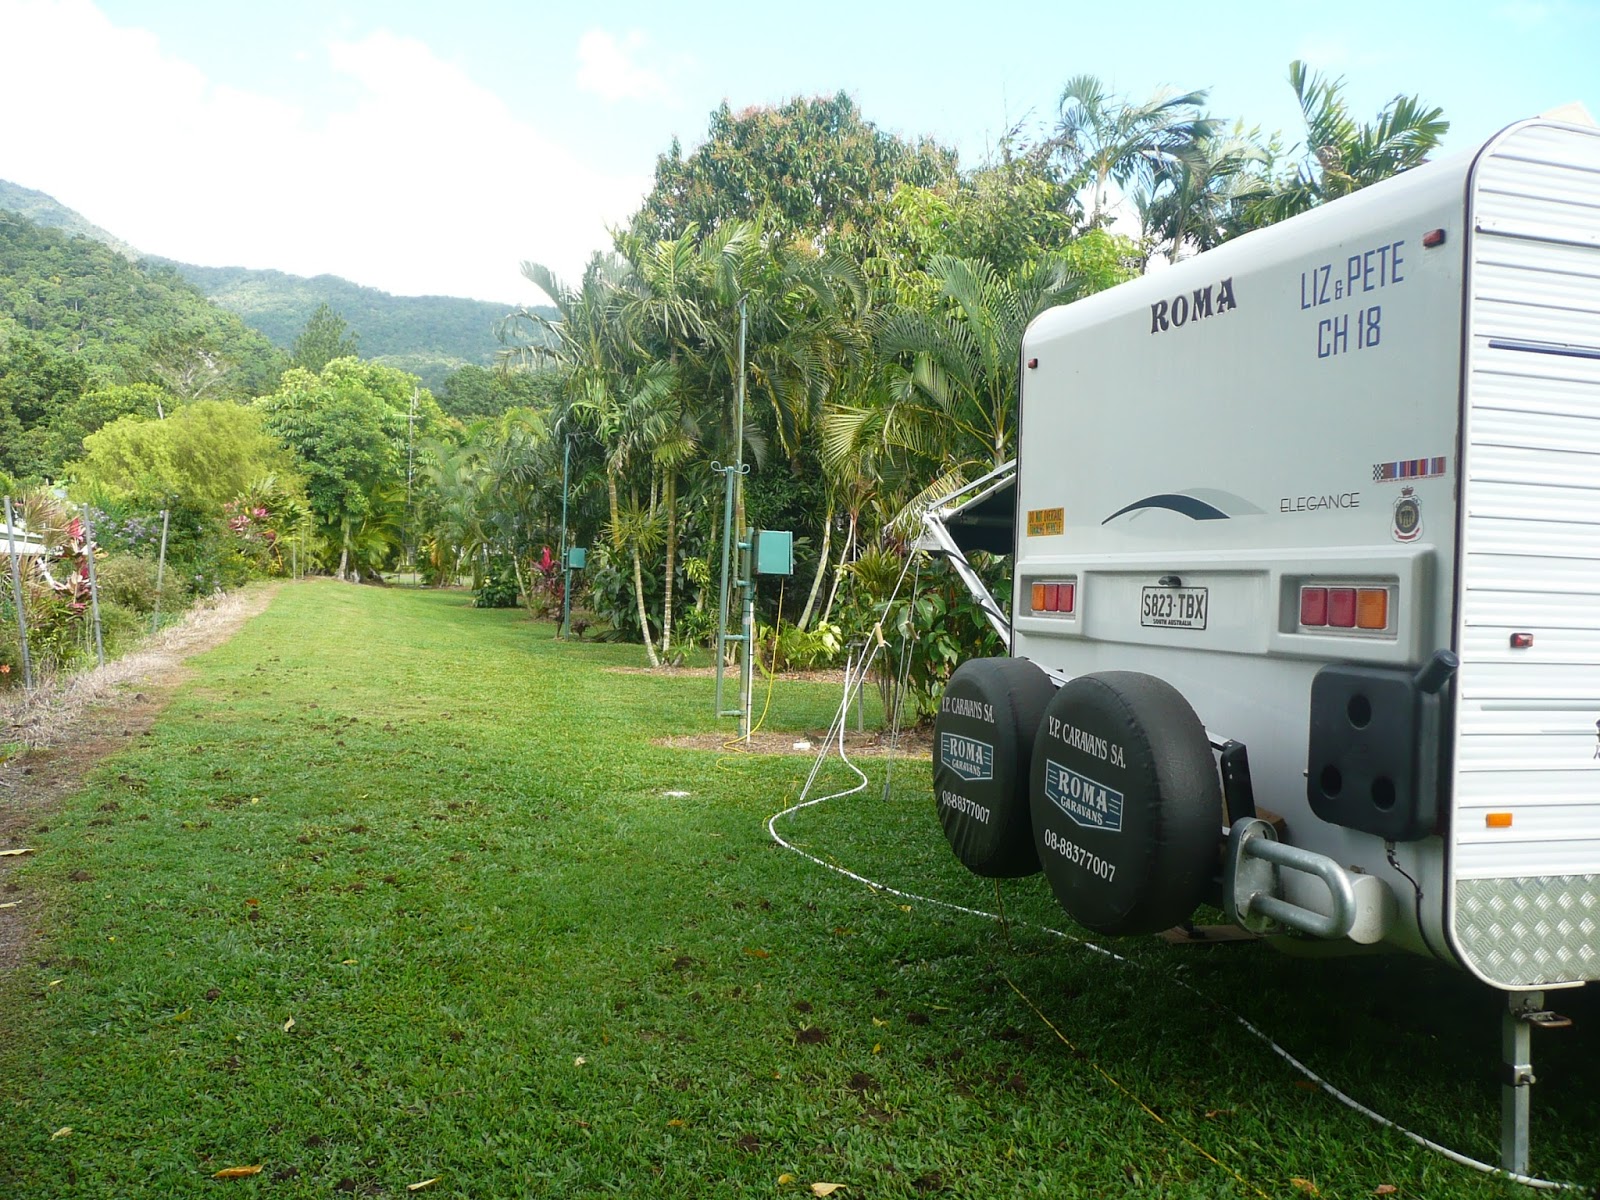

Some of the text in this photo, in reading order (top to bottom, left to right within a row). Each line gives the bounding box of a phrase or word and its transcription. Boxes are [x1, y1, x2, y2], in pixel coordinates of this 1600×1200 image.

[1151, 276, 1237, 335] ROMA
[1318, 305, 1381, 359] CH 18
[1280, 492, 1360, 513] ELEGANCE
[1168, 619, 1192, 627] AUSTRALIA
[951, 697, 982, 720] CARAVANS
[949, 737, 984, 765] ROMA
[1062, 723, 1108, 760] CARAVANS
[951, 758, 981, 777] CARAVANS
[942, 790, 990, 824] 08-88377007
[1058, 770, 1108, 814] ROMA
[1060, 795, 1103, 825] CARAVANS
[1044, 829, 1116, 882] 08-88377007
